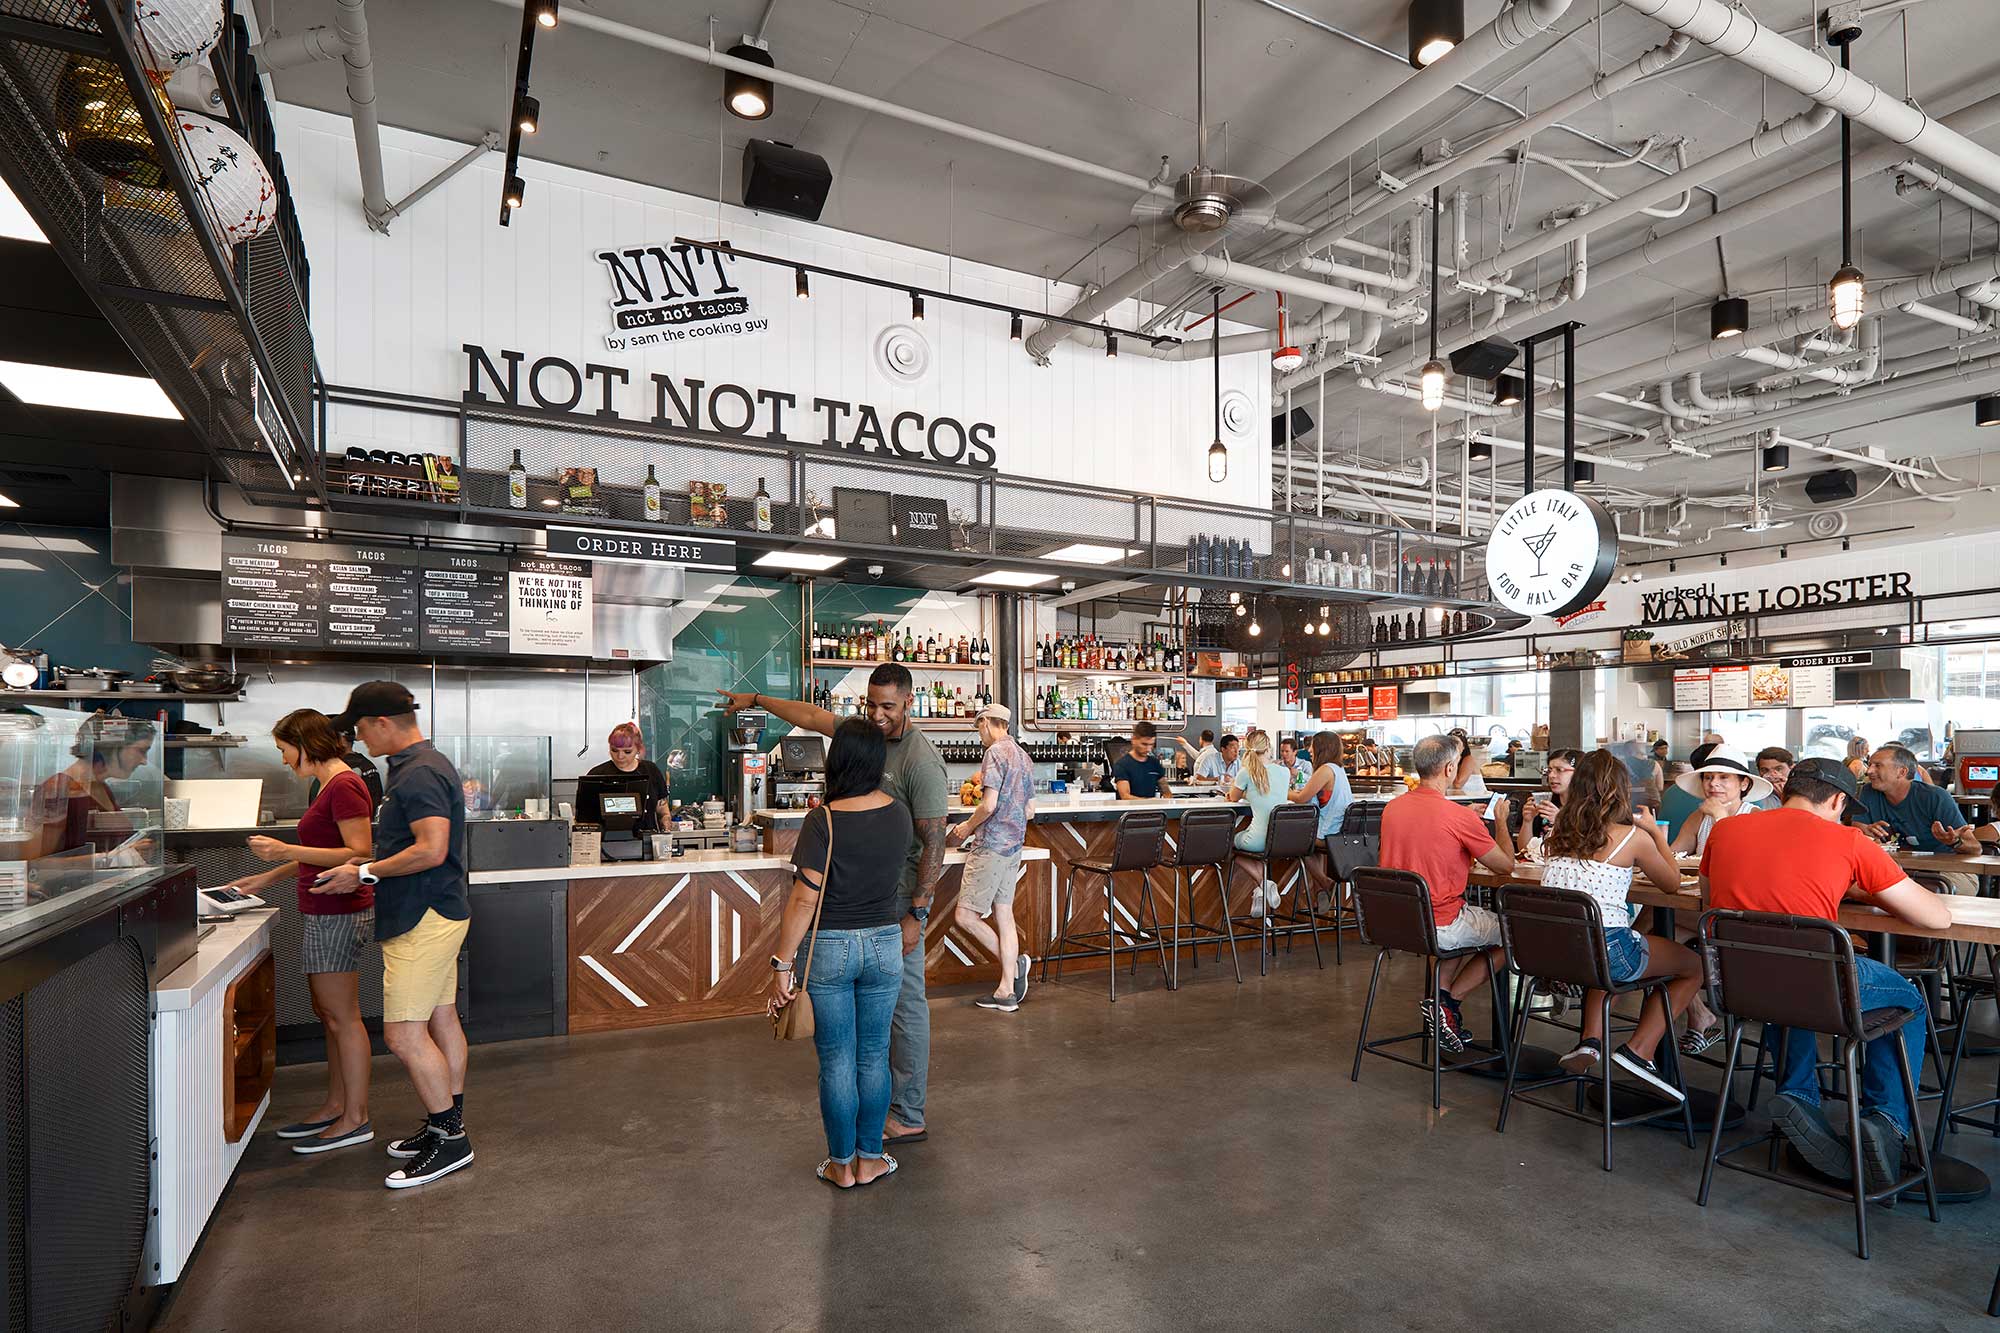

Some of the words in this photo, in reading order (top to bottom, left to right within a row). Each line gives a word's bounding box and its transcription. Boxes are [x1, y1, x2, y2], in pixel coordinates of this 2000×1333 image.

[599, 240, 740, 307] NNT
[625, 311, 656, 327] not
[662, 305, 693, 321] not
[698, 301, 744, 316] tacos
[607, 337, 626, 350] by
[631, 334, 660, 346] sam
[662, 328, 685, 341] the
[689, 322, 742, 338] cooking
[745, 318, 769, 334] guy
[462, 343, 629, 418] NOT
[651, 373, 796, 441] NOT
[813, 397, 997, 470] TACOS
[908, 511, 938, 525] NNT
[1501, 500, 1537, 536] LITTLE
[1547, 499, 1579, 521] ITALY
[257, 544, 288, 554] TACOS
[357, 550, 386, 560] TACOS
[576, 536, 643, 555] ORDER
[651, 542, 702, 560] HERE
[451, 558, 478, 567] TACOS
[559, 563, 582, 571] tacos
[518, 576, 545, 586] WE'RE
[548, 579, 564, 587] NOT
[568, 580, 582, 589] THE
[1497, 572, 1520, 600] FOOD
[1527, 590, 1557, 605] HALL
[1561, 562, 1584, 588] BAR
[518, 587, 547, 597] TACOS
[551, 589, 582, 599] YOU'RE
[1641, 583, 1715, 603] wicked!
[1641, 592, 1749, 625] MAINE
[1758, 572, 1913, 613] LOBSTER
[518, 597, 567, 610] THINKING
[570, 600, 582, 610] OF
[1673, 641, 1689, 651] OLD
[1690, 631, 1715, 645] NORTH
[1792, 657, 1824, 667] ORDER
[1827, 655, 1854, 664] HERE
[1287, 663, 1299, 705] ROA
